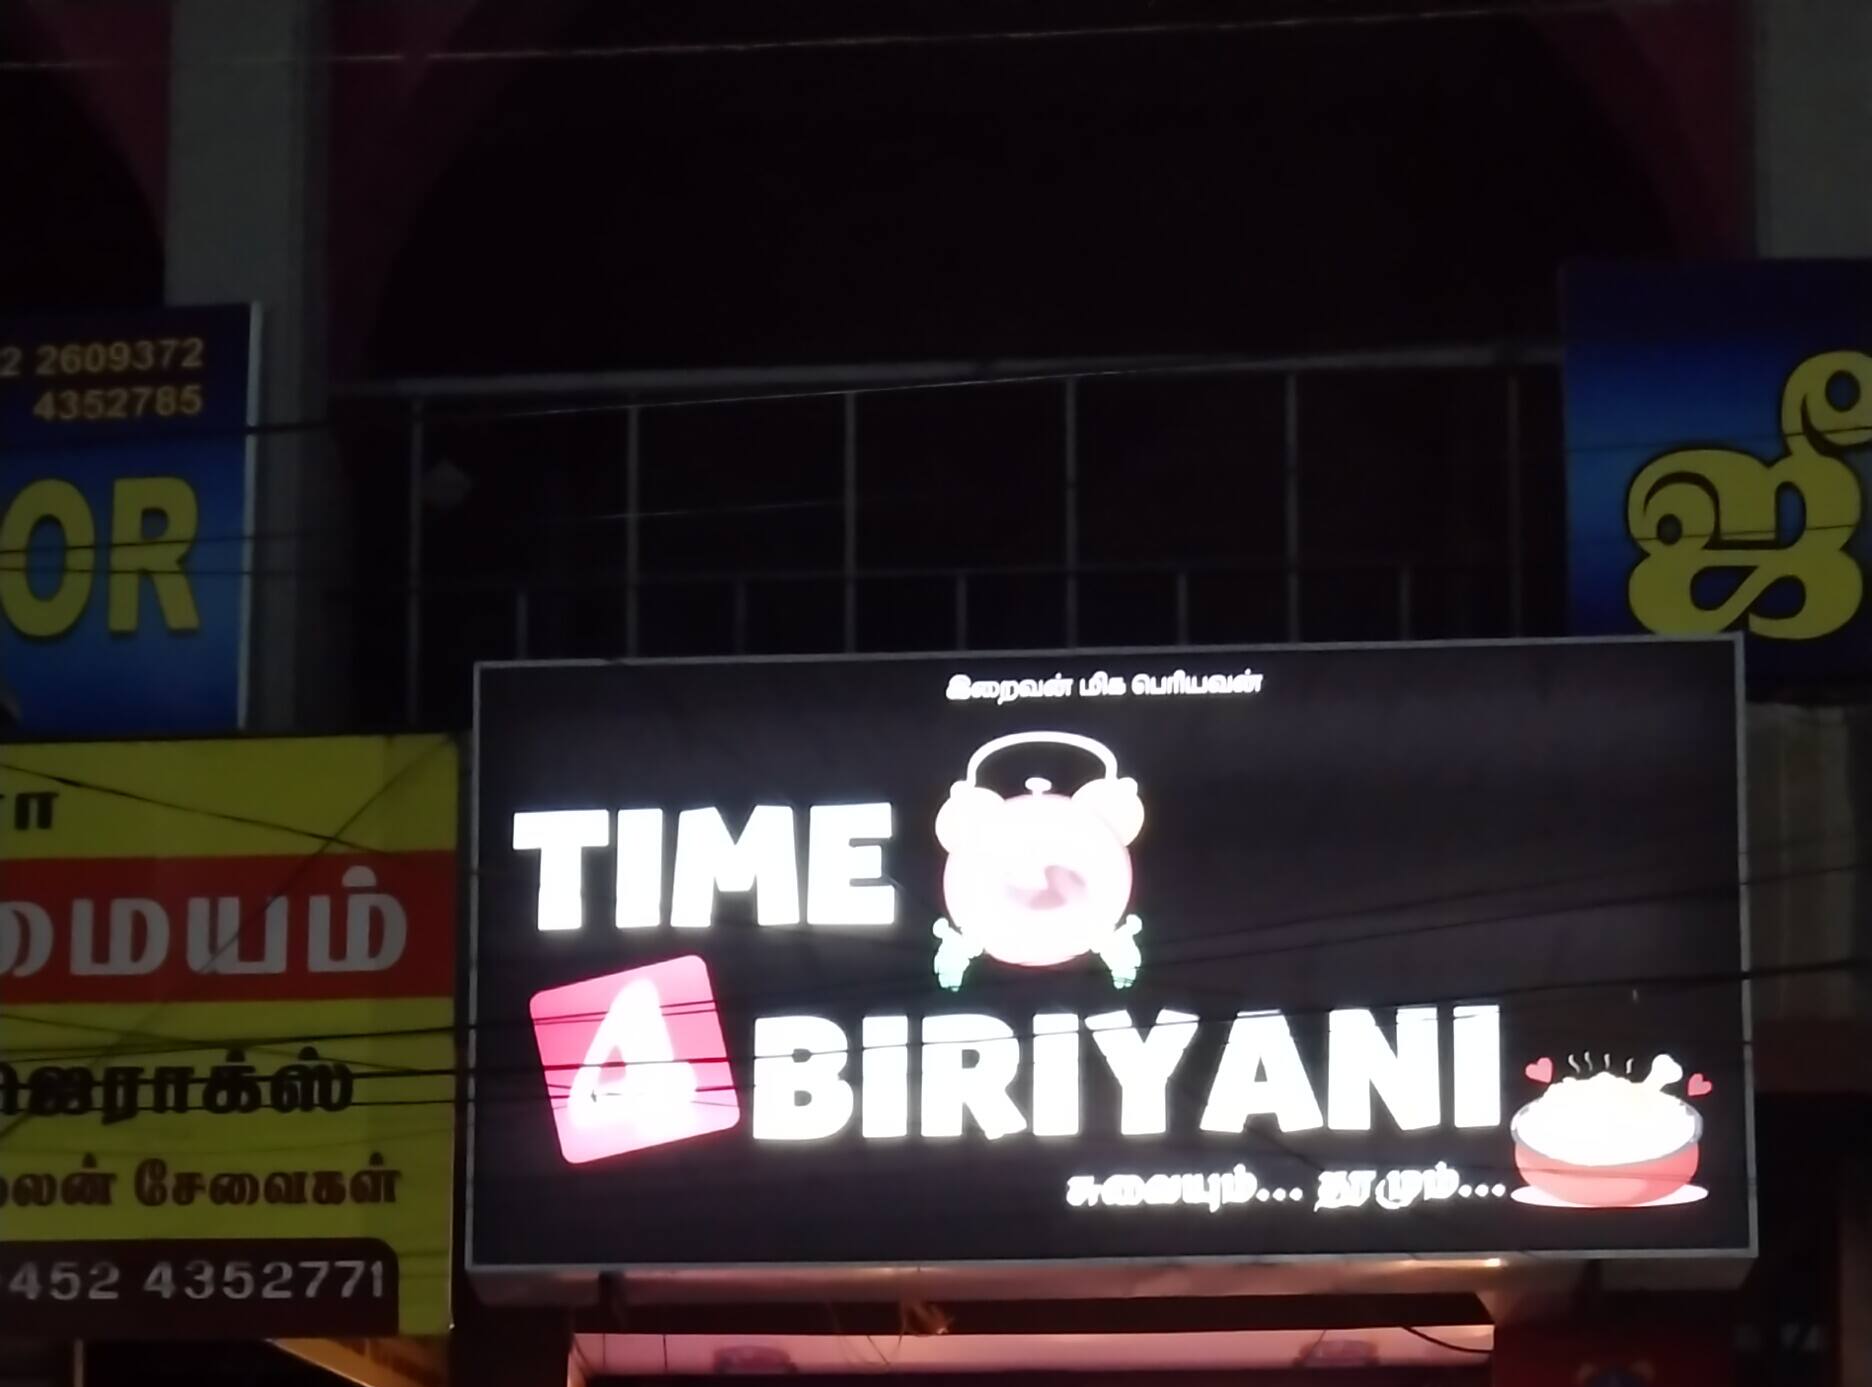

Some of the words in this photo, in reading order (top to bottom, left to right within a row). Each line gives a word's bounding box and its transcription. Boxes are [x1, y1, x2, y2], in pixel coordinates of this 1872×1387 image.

[36, 338, 204, 375] 2609372
[34, 386, 203, 421] 4352785
[0, 477, 200, 638] OR
[946, 672, 1074, 706] இறைவன்
[1079, 671, 1127, 696] மிக
[1132, 668, 1264, 695] பெரியவன்
[512, 802, 896, 931] TIME
[566, 976, 700, 1142] 4
[752, 1003, 1501, 1142] BIRIYANI
[136, 1152, 402, 1207] சேவைகள்
[144, 1260, 384, 1300] 4352771
